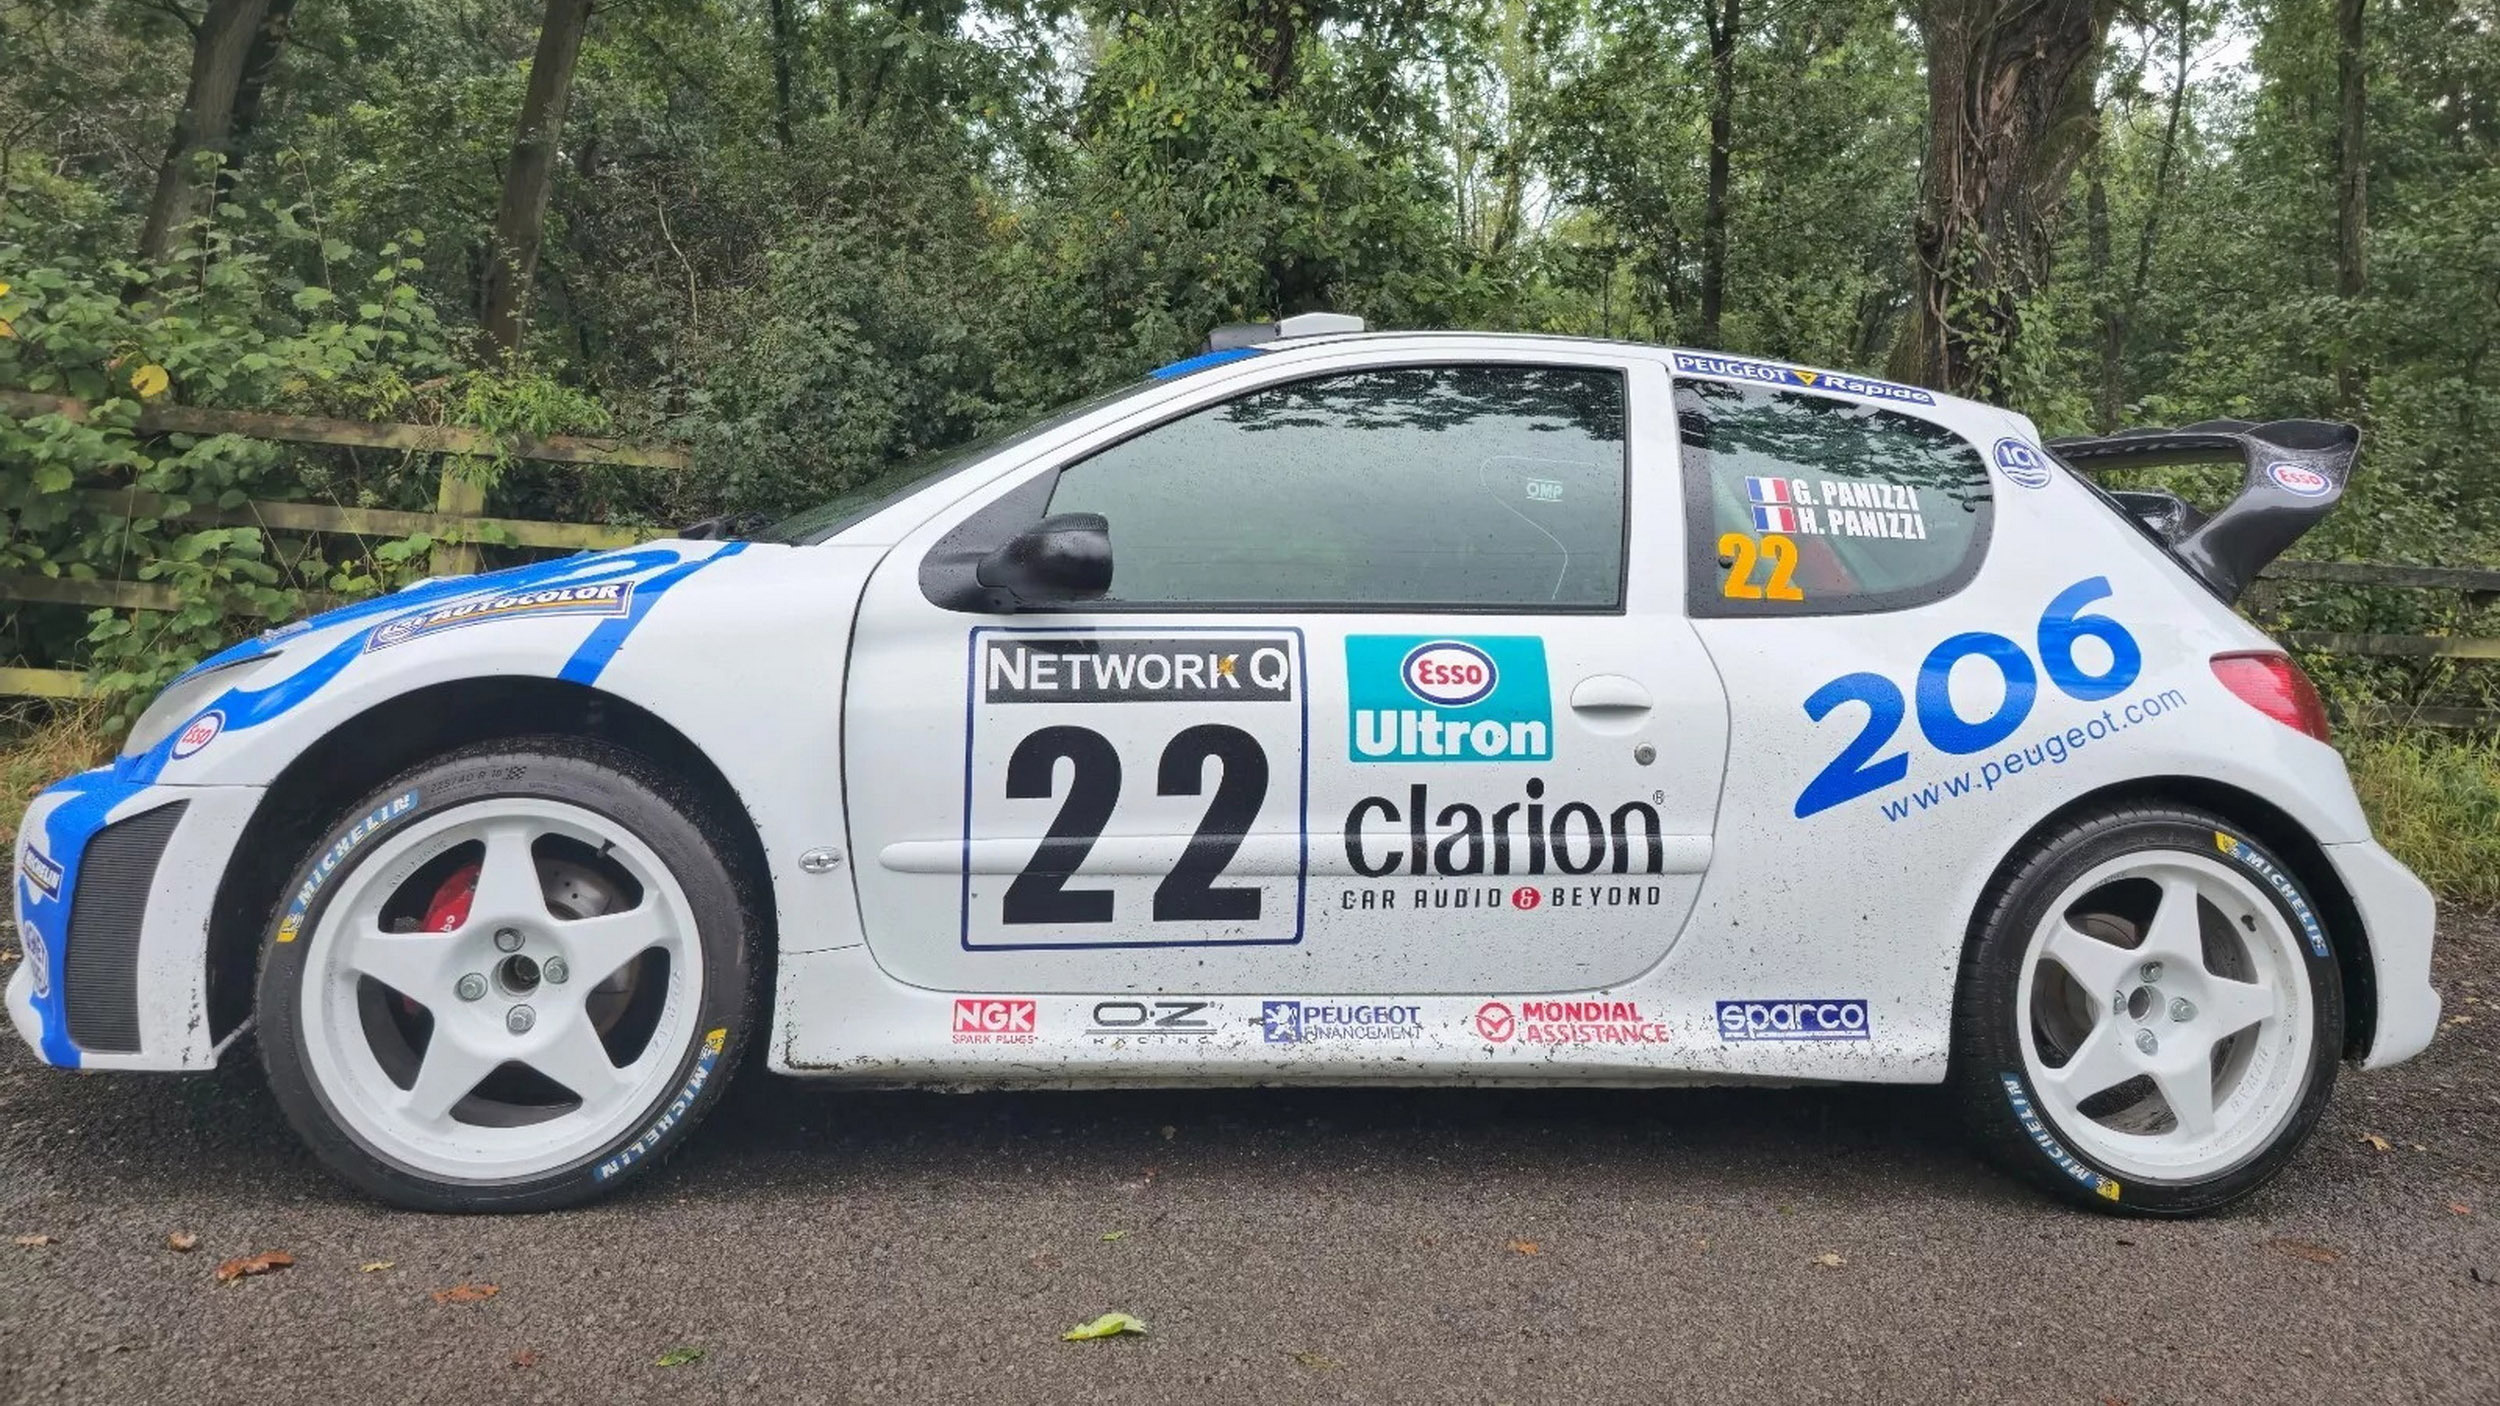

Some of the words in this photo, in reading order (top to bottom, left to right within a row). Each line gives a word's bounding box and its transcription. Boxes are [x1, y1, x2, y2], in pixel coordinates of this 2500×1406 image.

[1677, 356, 1788, 383] PEUGEOT
[1823, 375, 1932, 404] Rapide
[2001, 445, 2040, 469] ICI
[1526, 482, 1564, 499] OMP
[1793, 480, 1819, 506] G.
[1820, 480, 1921, 511] PANIZZI
[1797, 506, 1825, 535] H.
[1828, 507, 1927, 540] PANIZZI
[1717, 532, 1804, 600] 22
[428, 585, 619, 624] AUTOCOLOR
[988, 647, 1242, 691] NETWORK
[1249, 647, 1290, 692] Q
[1418, 659, 1483, 686] Esso
[1794, 576, 2142, 819] 206
[1355, 709, 1547, 757] Ultron
[1881, 686, 2188, 823] www.peugeot.com
[1002, 723, 1269, 925] 22
[298, 794, 410, 906] MICHELIN
[1342, 889, 1396, 910] CAR
[1414, 888, 1501, 909] AUDIO
[1551, 886, 1661, 908] BEYOND
[955, 1002, 1035, 1032] NGK
[1303, 1005, 1422, 1025] PEUGEOT
[1522, 1002, 1644, 1022] MONDIAL
[1721, 1003, 1866, 1039] sparco
[952, 1034, 991, 1045] SPARK
[996, 1034, 1035, 1045] PLUGS
[1302, 1025, 1422, 1040] FINANCEMENT
[1527, 1024, 1669, 1044] ASSISTANCE
[601, 1064, 710, 1179] MICHELIN
[2003, 1080, 2089, 1181] MICHELIN
